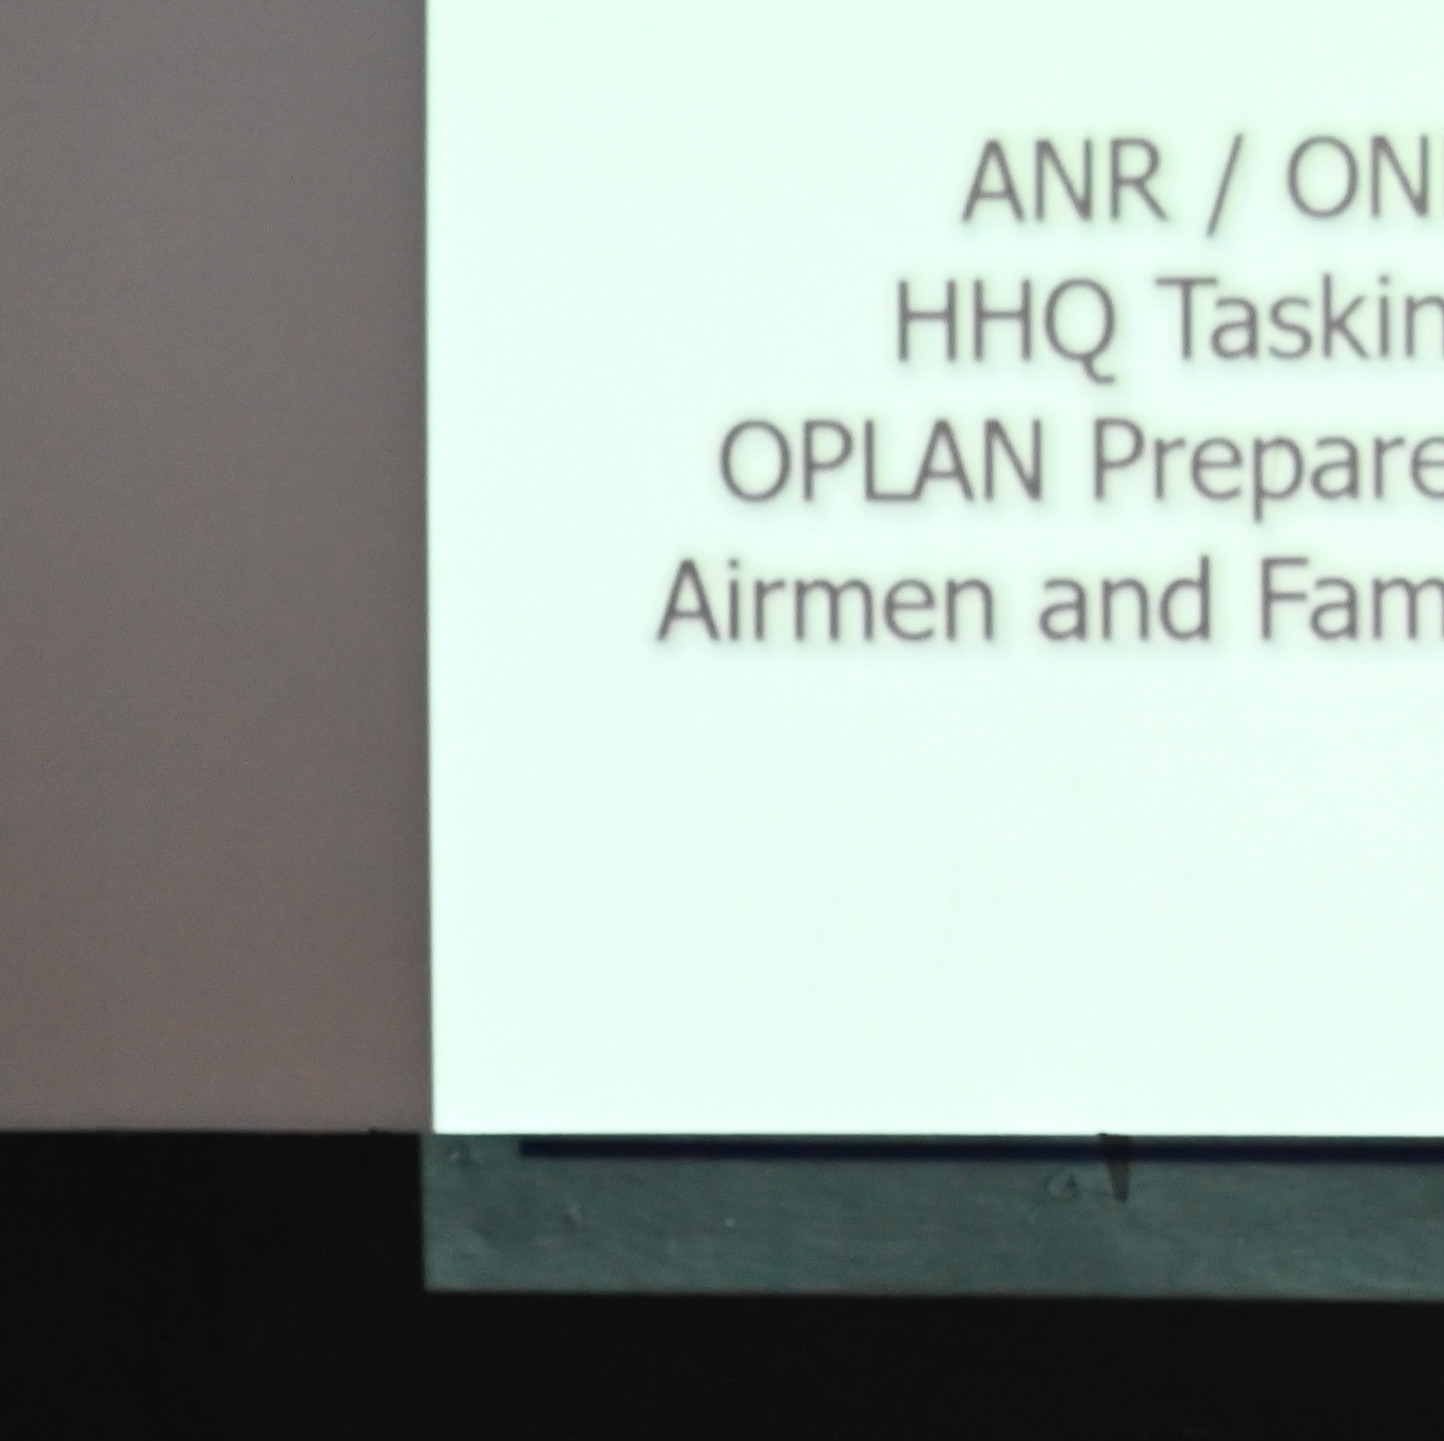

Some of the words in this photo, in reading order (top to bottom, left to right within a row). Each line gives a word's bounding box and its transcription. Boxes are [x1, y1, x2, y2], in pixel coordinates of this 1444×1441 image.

[961, 137, 1169, 223] ANR
[1206, 133, 1245, 238] /
[896, 276, 1118, 386] HHQ
[719, 416, 1045, 504] OPLAN
[656, 557, 996, 643] Airmen
[1037, 553, 1212, 643] and
